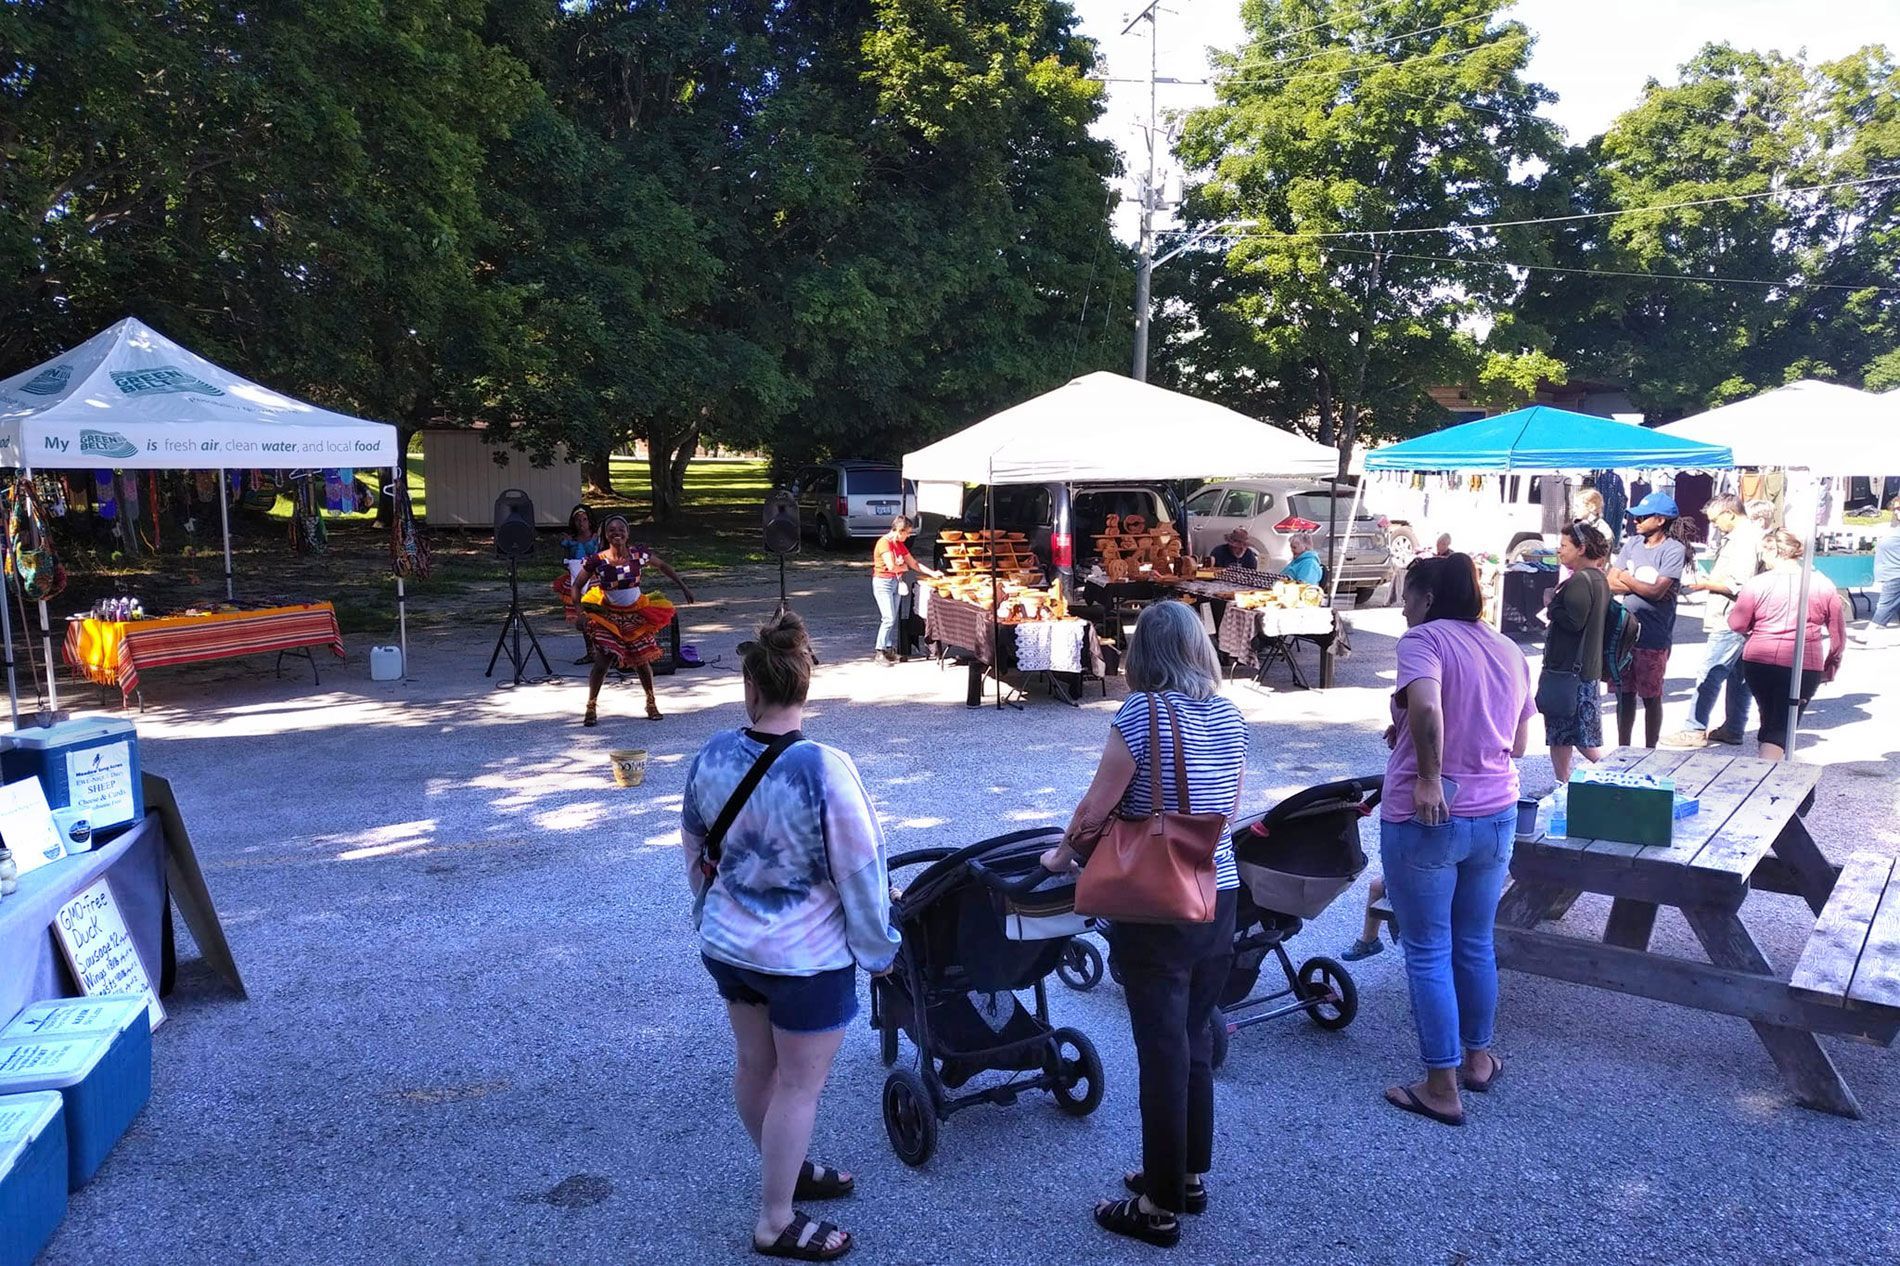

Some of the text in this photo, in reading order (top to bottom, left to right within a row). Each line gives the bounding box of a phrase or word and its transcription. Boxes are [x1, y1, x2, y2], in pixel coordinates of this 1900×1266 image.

[115, 371, 183, 386] GREEN
[119, 379, 172, 393] BELT
[44, 436, 70, 452] My
[80, 433, 117, 444] GREEN
[146, 438, 158, 451] is
[165, 438, 197, 451] fresh
[225, 439, 258, 452] clean
[302, 440, 323, 453] and
[326, 440, 352, 453] local
[80, 442, 108, 451] BELT
[87, 780, 116, 794] SHEEP
[60, 892, 108, 931] GMO-Free
[74, 943, 112, 975] Sausage
[83, 969, 107, 990] Wings
